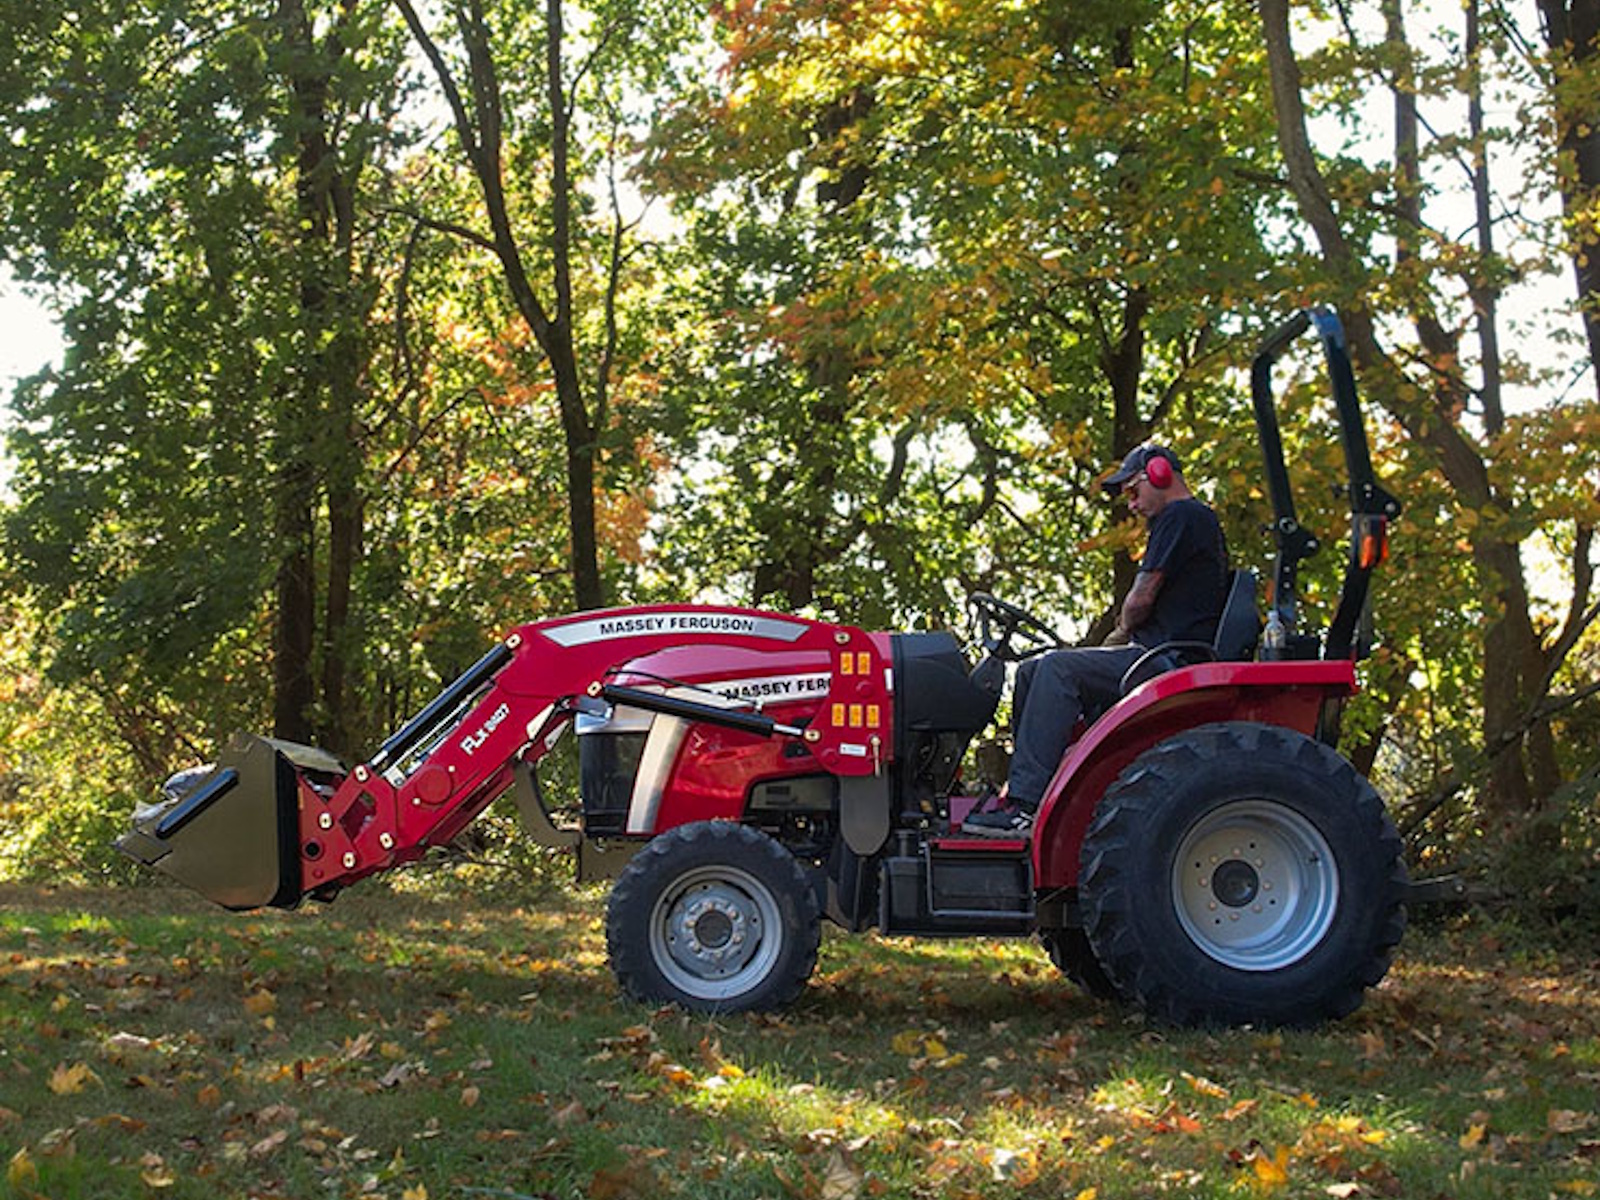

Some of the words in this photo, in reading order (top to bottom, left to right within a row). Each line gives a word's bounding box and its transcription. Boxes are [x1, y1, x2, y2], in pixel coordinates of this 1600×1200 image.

[600, 618, 664, 635] MASSEY
[669, 617, 753, 631] FERGUSON
[725, 681, 791, 699] MASSEY
[797, 678, 832, 692] FER
